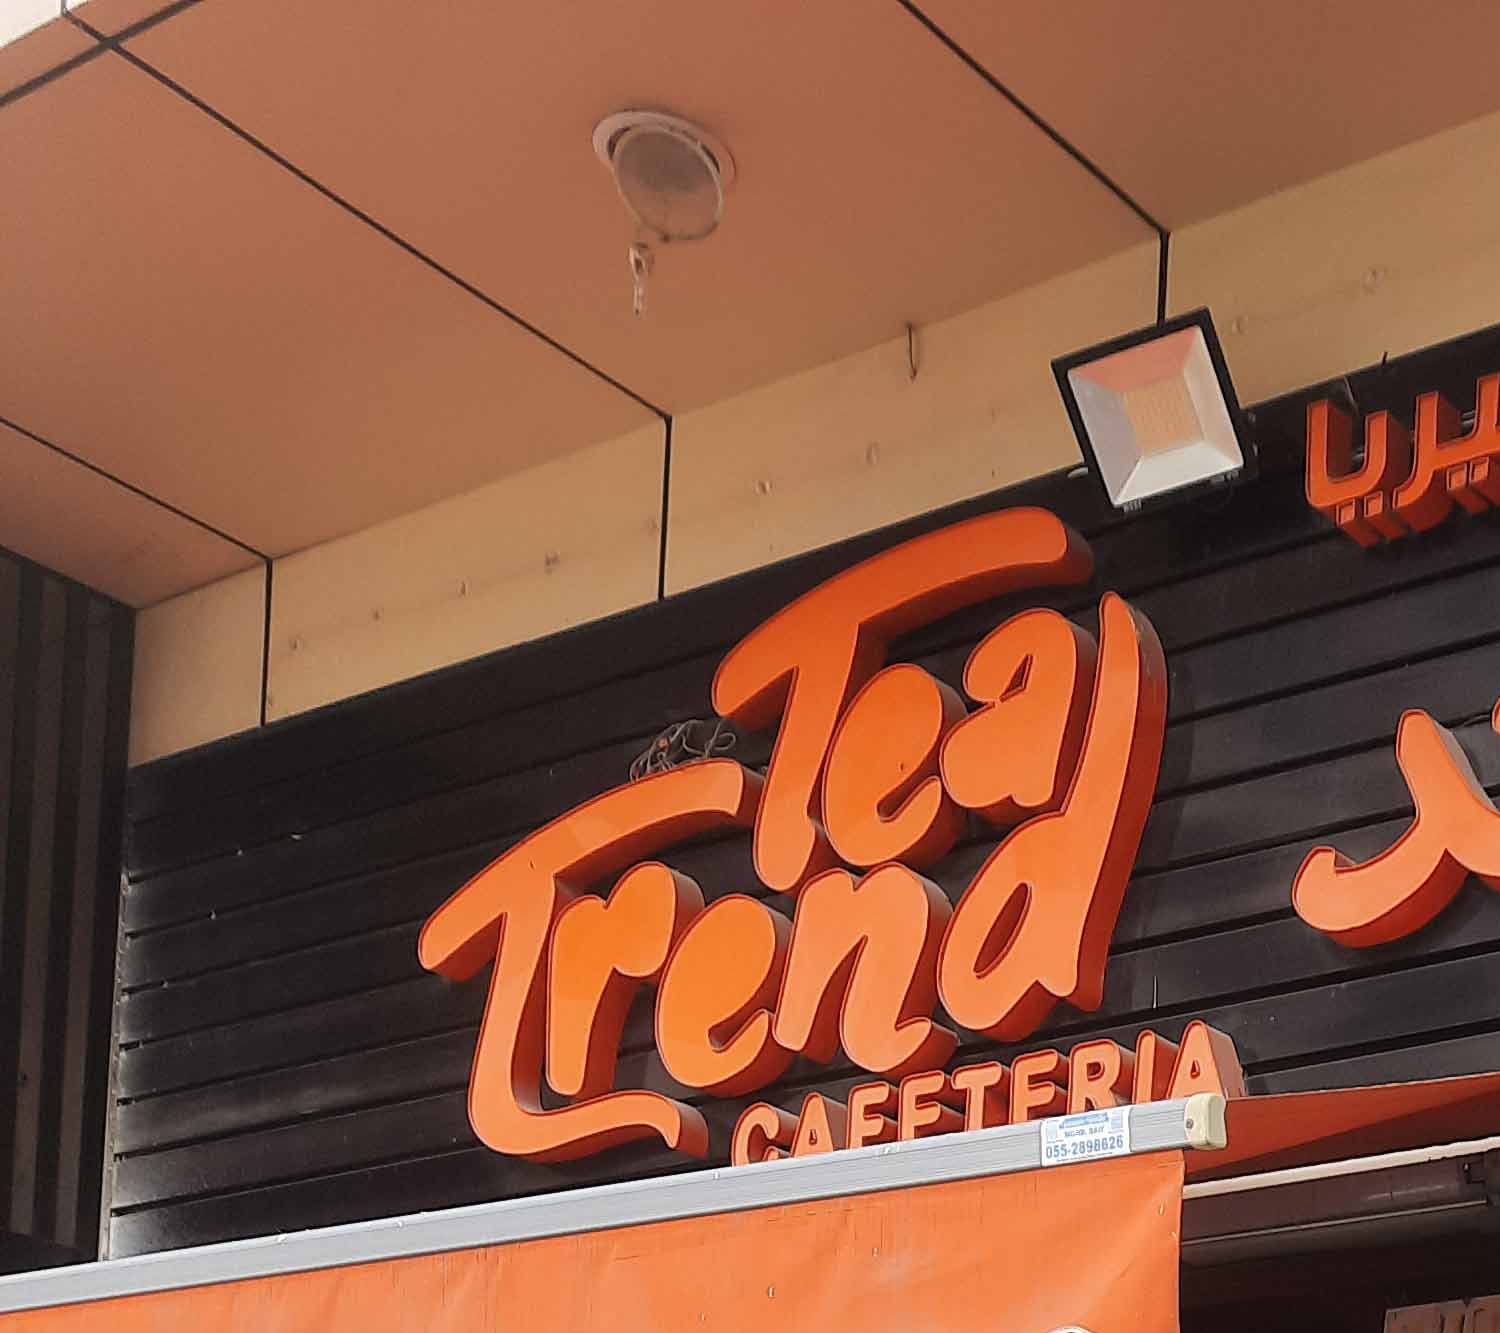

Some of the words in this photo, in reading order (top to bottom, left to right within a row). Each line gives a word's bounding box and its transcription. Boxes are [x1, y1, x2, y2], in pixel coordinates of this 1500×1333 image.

[418, 591, 1169, 1160] Trend
[711, 505, 1096, 892] Tea
[732, 1020, 1240, 1168] CAFETERIA
